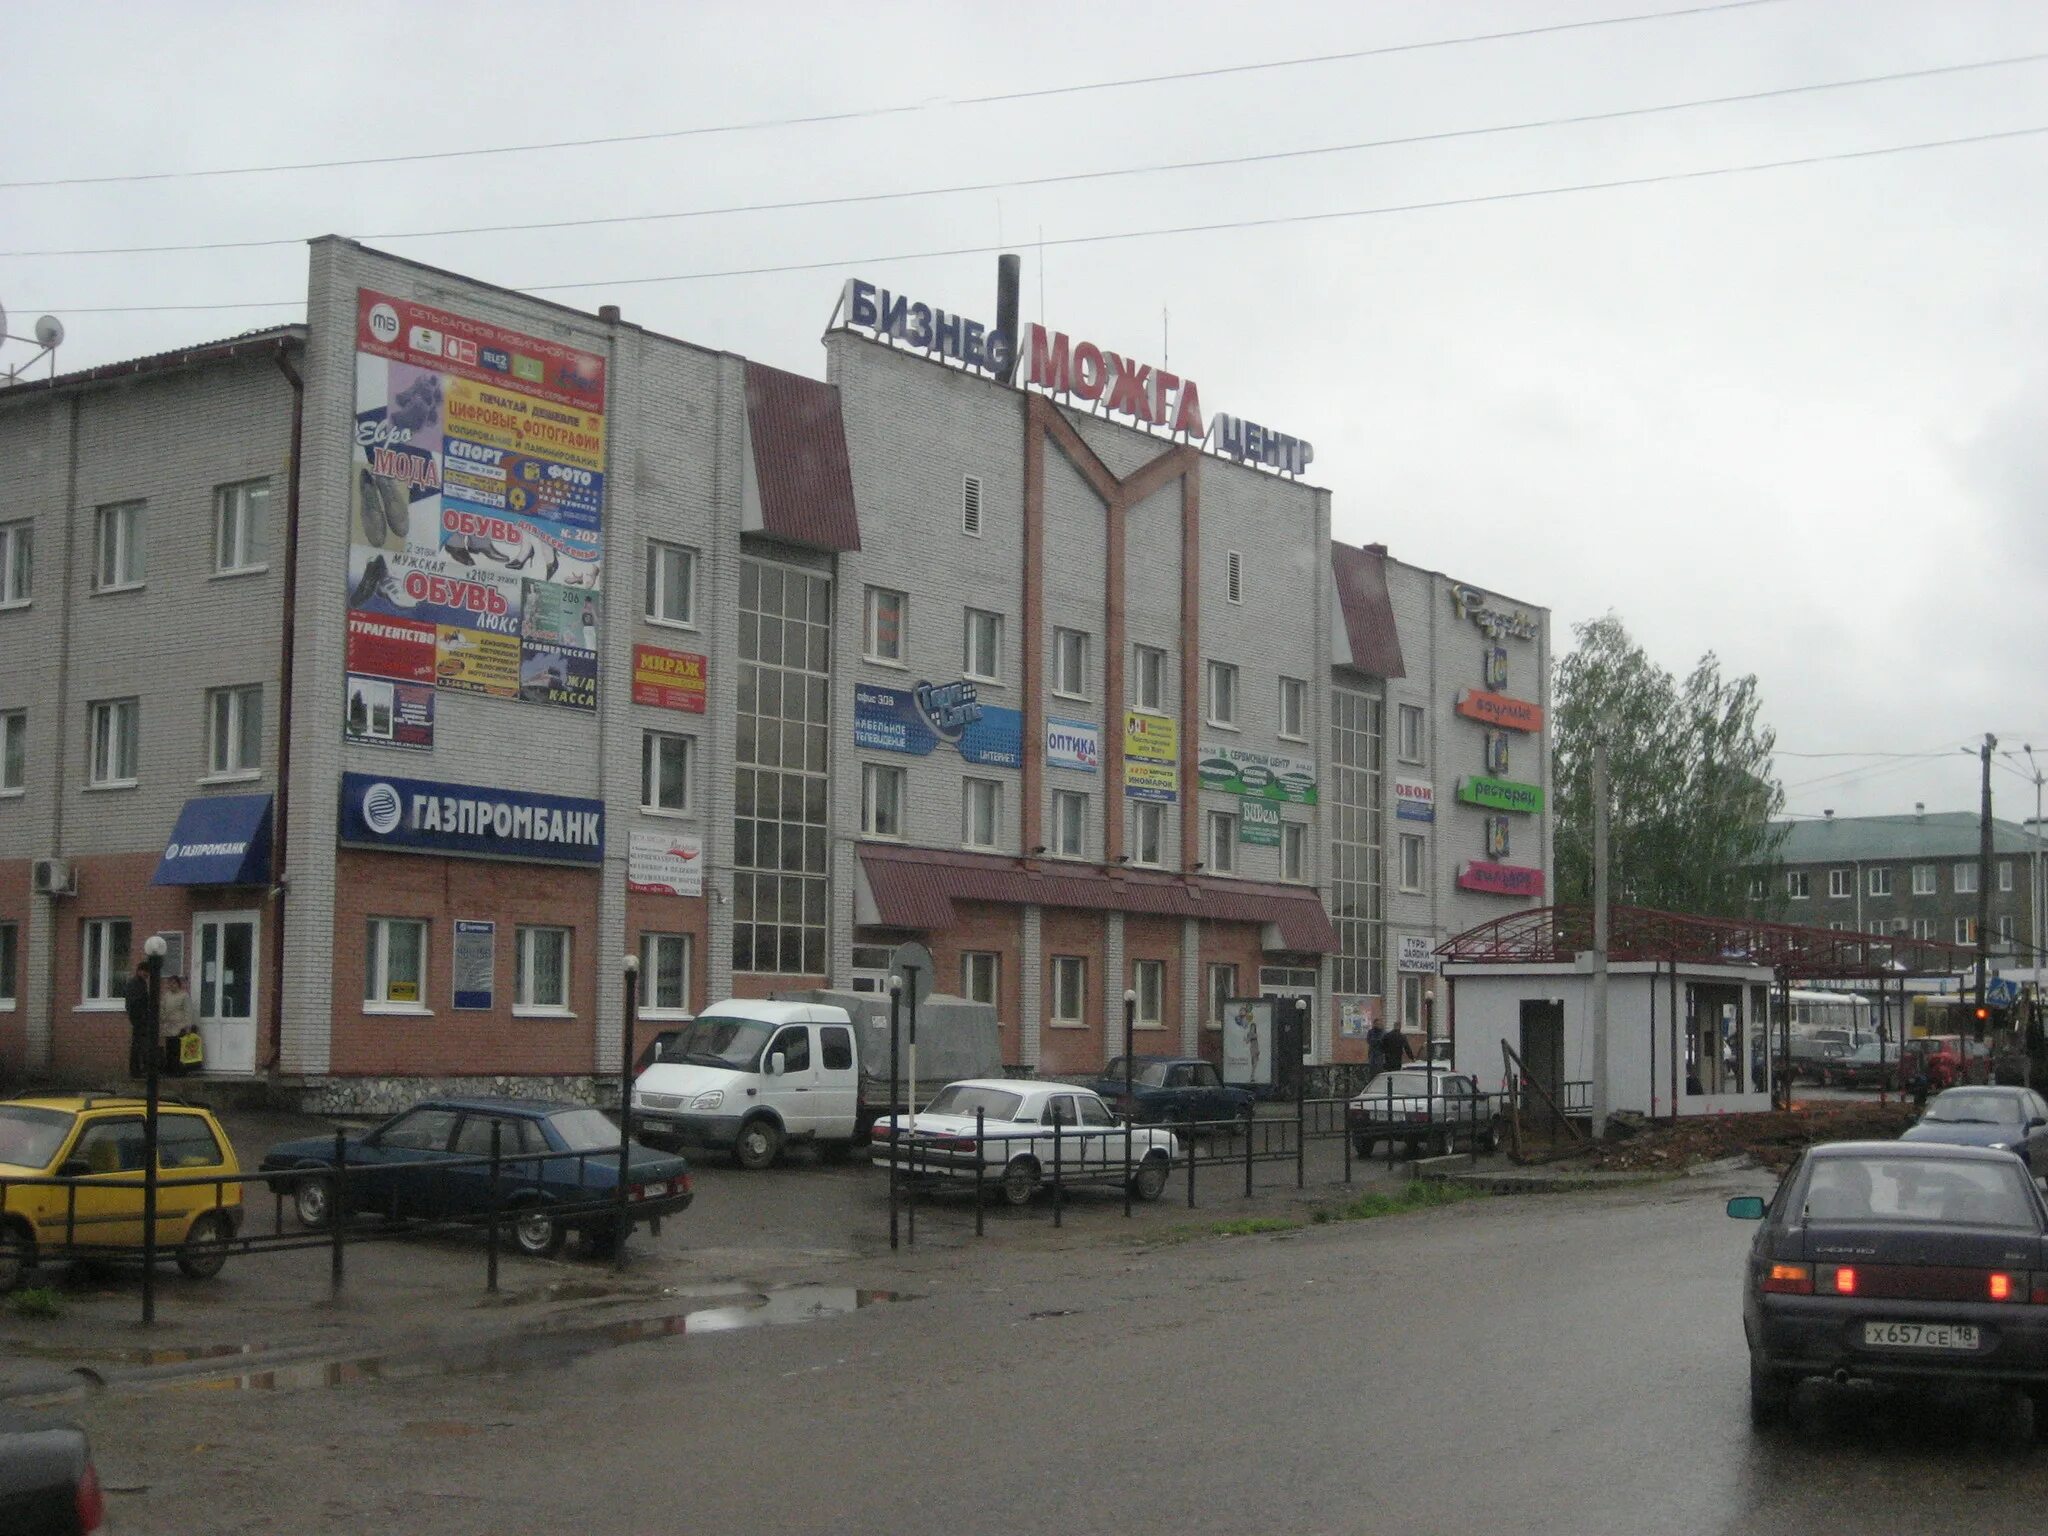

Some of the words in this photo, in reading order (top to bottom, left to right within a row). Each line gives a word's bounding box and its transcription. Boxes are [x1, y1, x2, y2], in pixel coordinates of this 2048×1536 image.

[846, 278, 1006, 376] БИЗНЕС
[1024, 322, 1204, 441] МОЖГА
[449, 400, 518, 432] ЦИФРОВЫЕ
[523, 420, 600, 450] ФОТОГРАФИИ
[449, 439, 504, 467] СПОРТ
[1215, 413, 1314, 475] ЦЕНТР
[372, 446, 441, 491] МОДА
[548, 464, 592, 486] ФОТО
[442, 509, 523, 544] ОБУВЬ
[574, 528, 599, 544] 202
[391, 553, 448, 574] МУЖСКАЯ
[404, 570, 509, 617] ОБУВЬ
[349, 619, 437, 646] ТУРАГЕНТСТВО
[476, 612, 519, 633] ЛЮКС
[522, 640, 598, 661] КОММЕРЧЕСКАЯ
[549, 688, 596, 707] КАССА
[1048, 732, 1097, 756] ОПТИКА
[411, 795, 600, 846] ГАЗПРОМБАНК
[1873, 1324, 1950, 1347] Х657СЕ
[1957, 1326, 1974, 1342] 18
